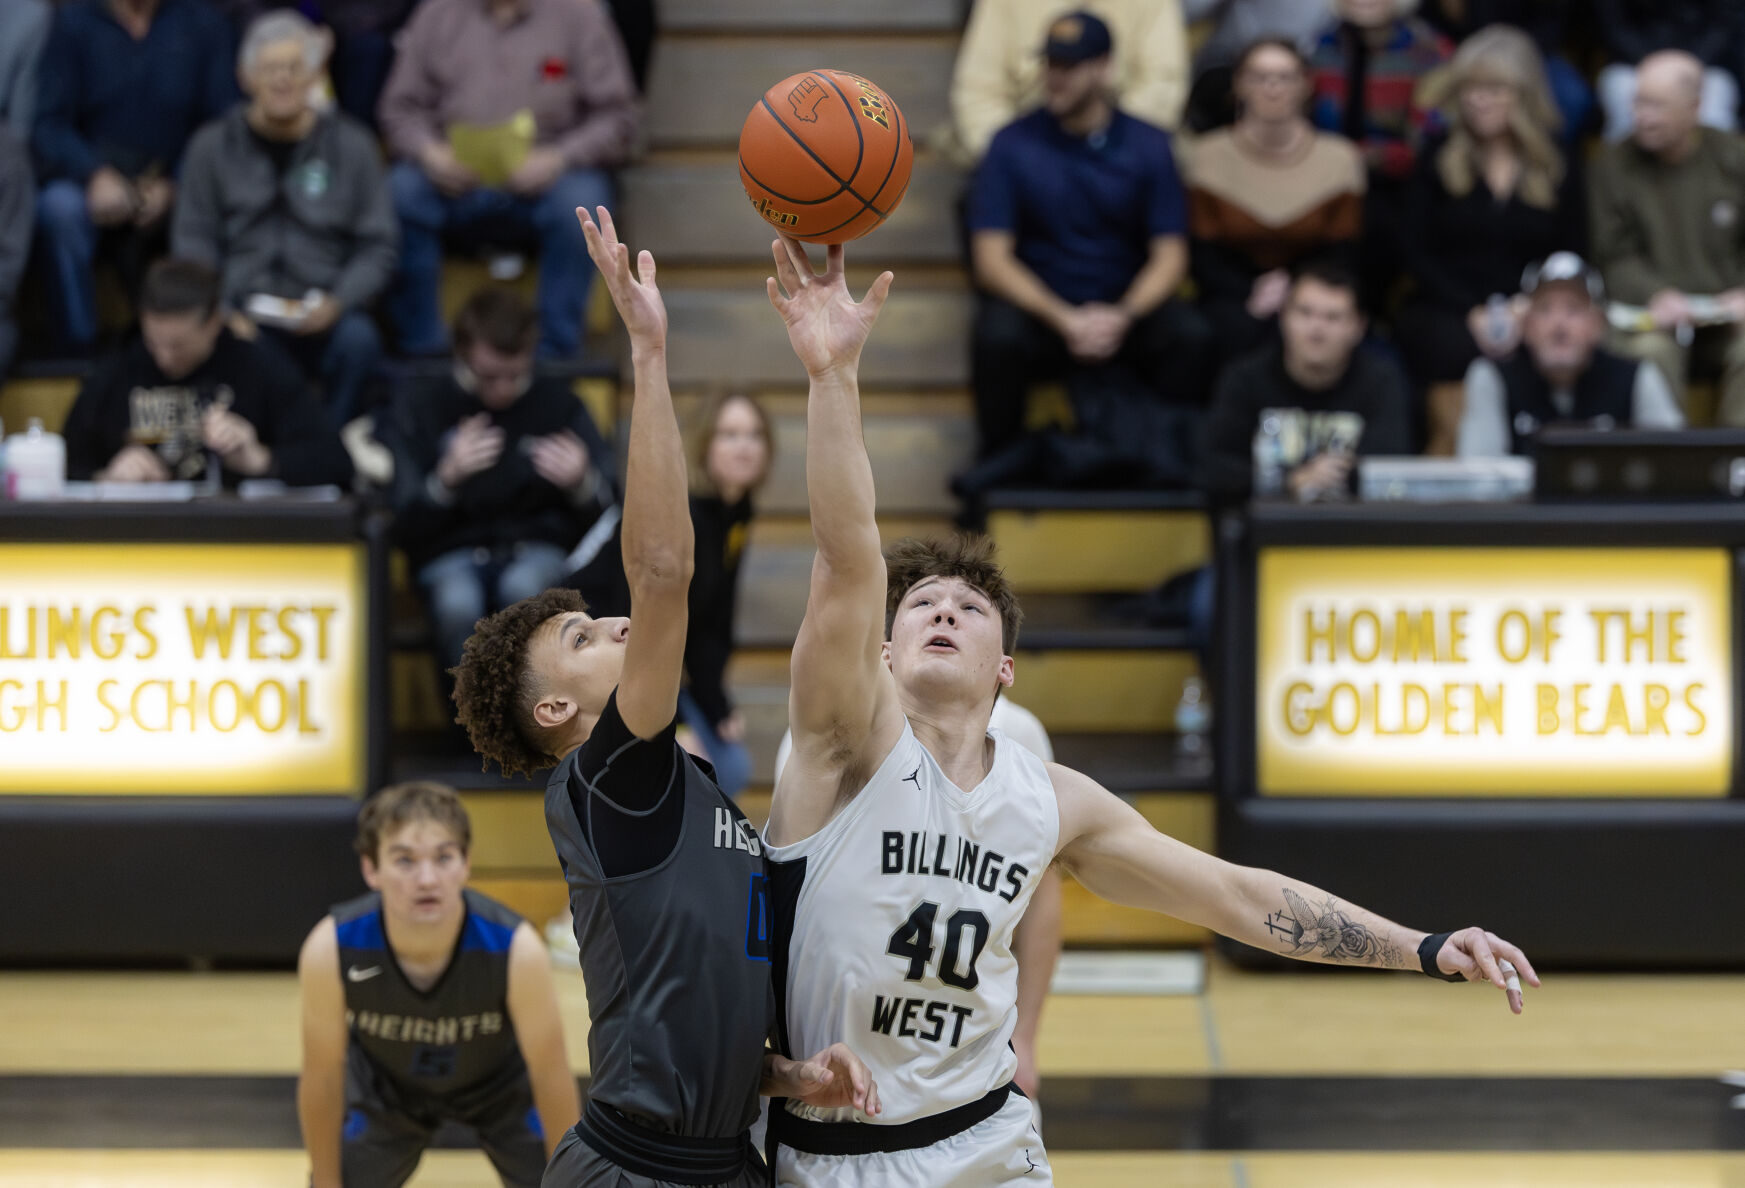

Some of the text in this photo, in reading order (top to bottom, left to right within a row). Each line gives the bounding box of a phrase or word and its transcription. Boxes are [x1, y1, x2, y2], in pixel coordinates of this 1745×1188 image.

[184, 606, 336, 660] WEST
[1304, 609, 1688, 663] HOME OF THE
[96, 679, 319, 733] SCHOOL
[1283, 682, 1706, 735] GOLDEN BEARS
[880, 829, 1029, 904] BILLINGS
[885, 899, 992, 992] 40
[870, 994, 974, 1049] WEST
